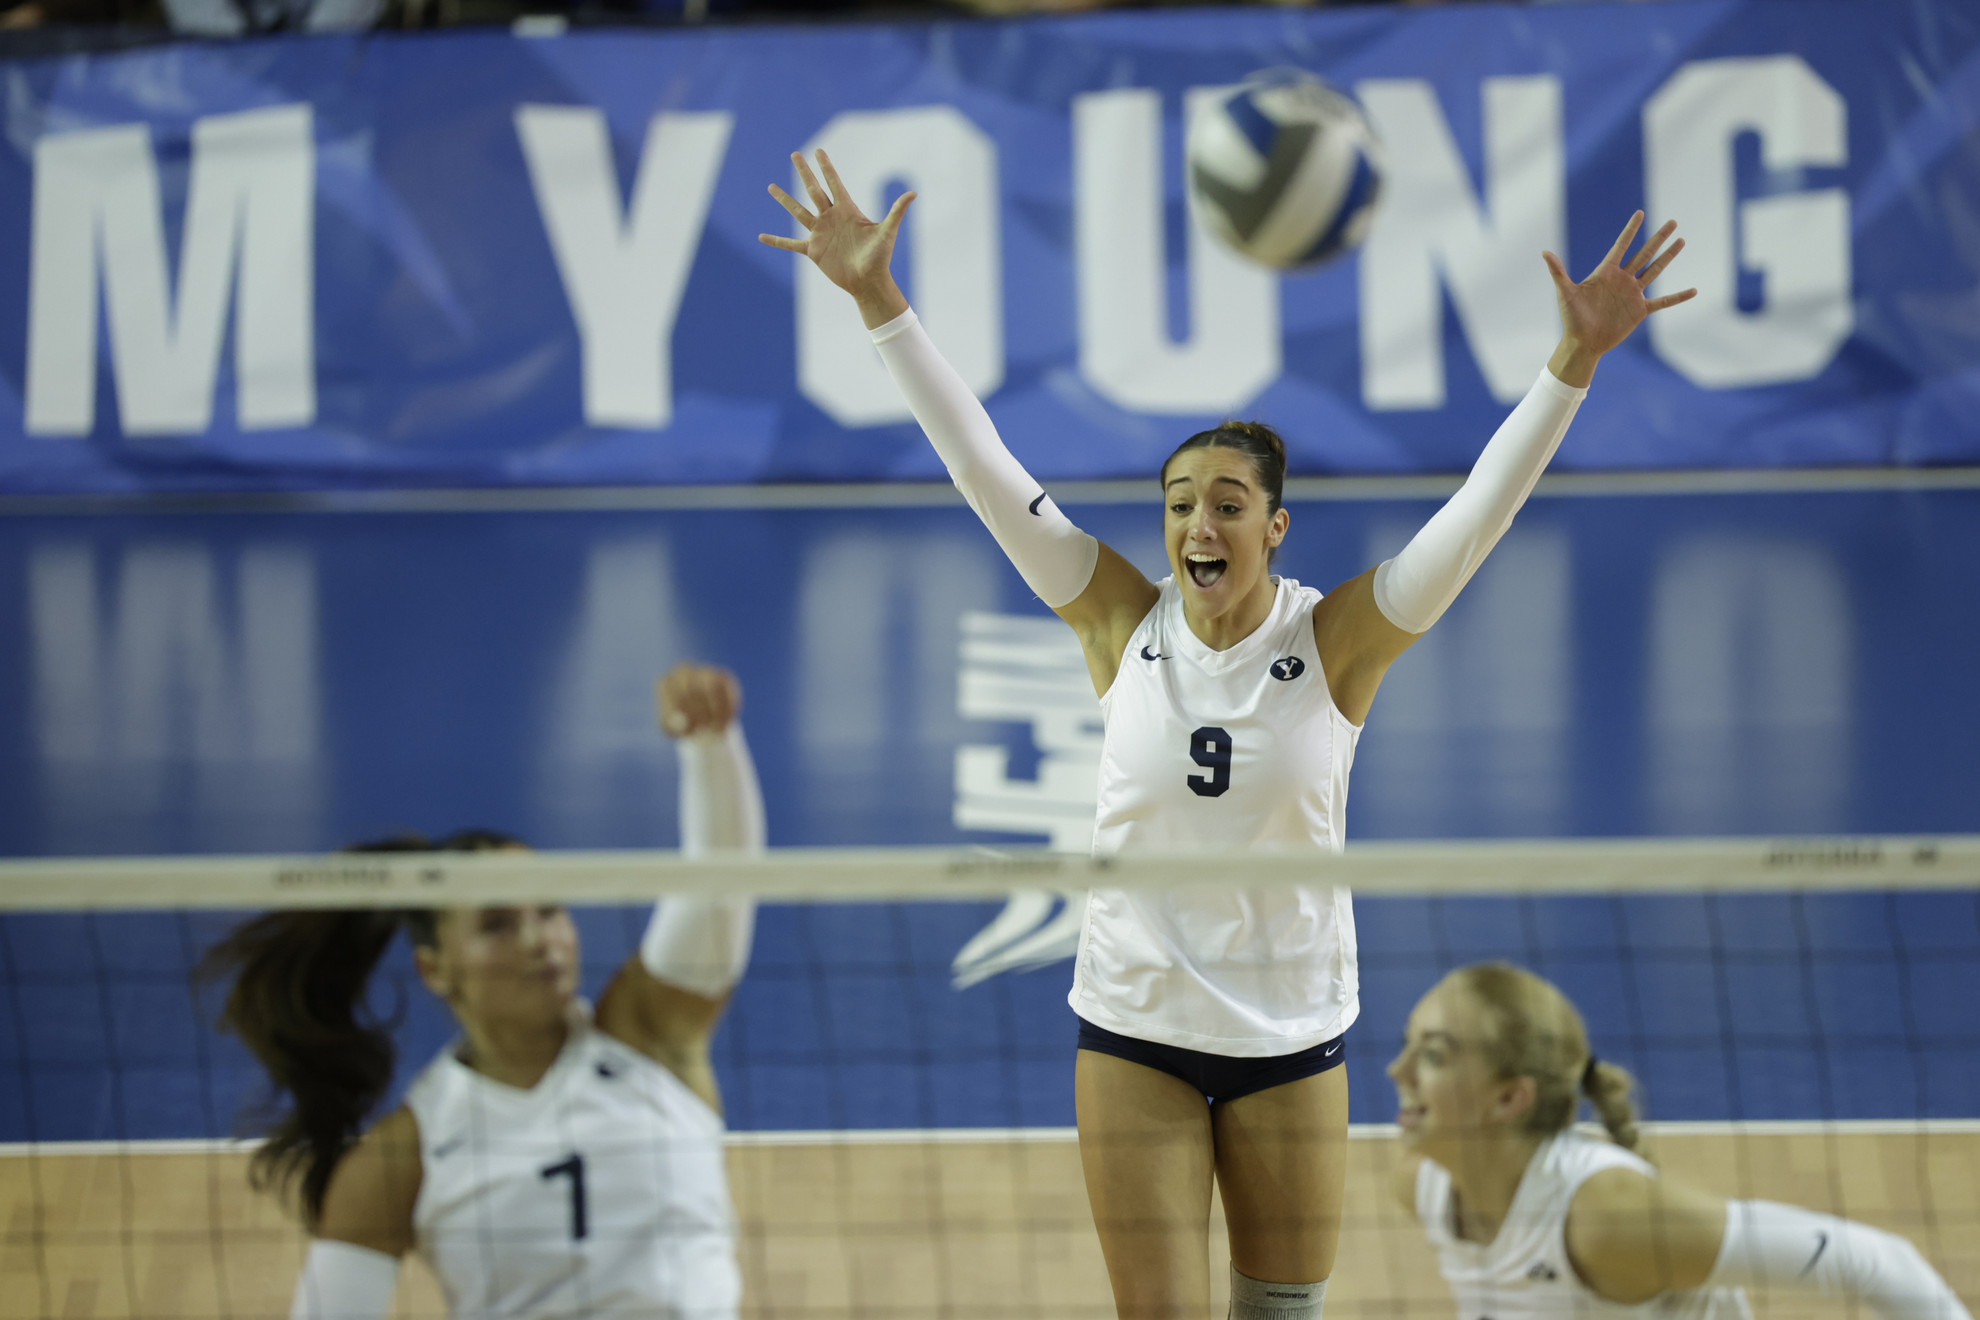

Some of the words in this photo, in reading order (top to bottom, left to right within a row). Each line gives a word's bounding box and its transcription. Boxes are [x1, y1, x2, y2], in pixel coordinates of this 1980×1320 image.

[25, 103, 315, 437] M
[515, 54, 1853, 428] YOUNG
[1275, 658, 1298, 680] Y
[1187, 726, 1233, 798] 9
[540, 1152, 590, 1242] 1
[1266, 1291, 1309, 1299] INCREDIWEAR
